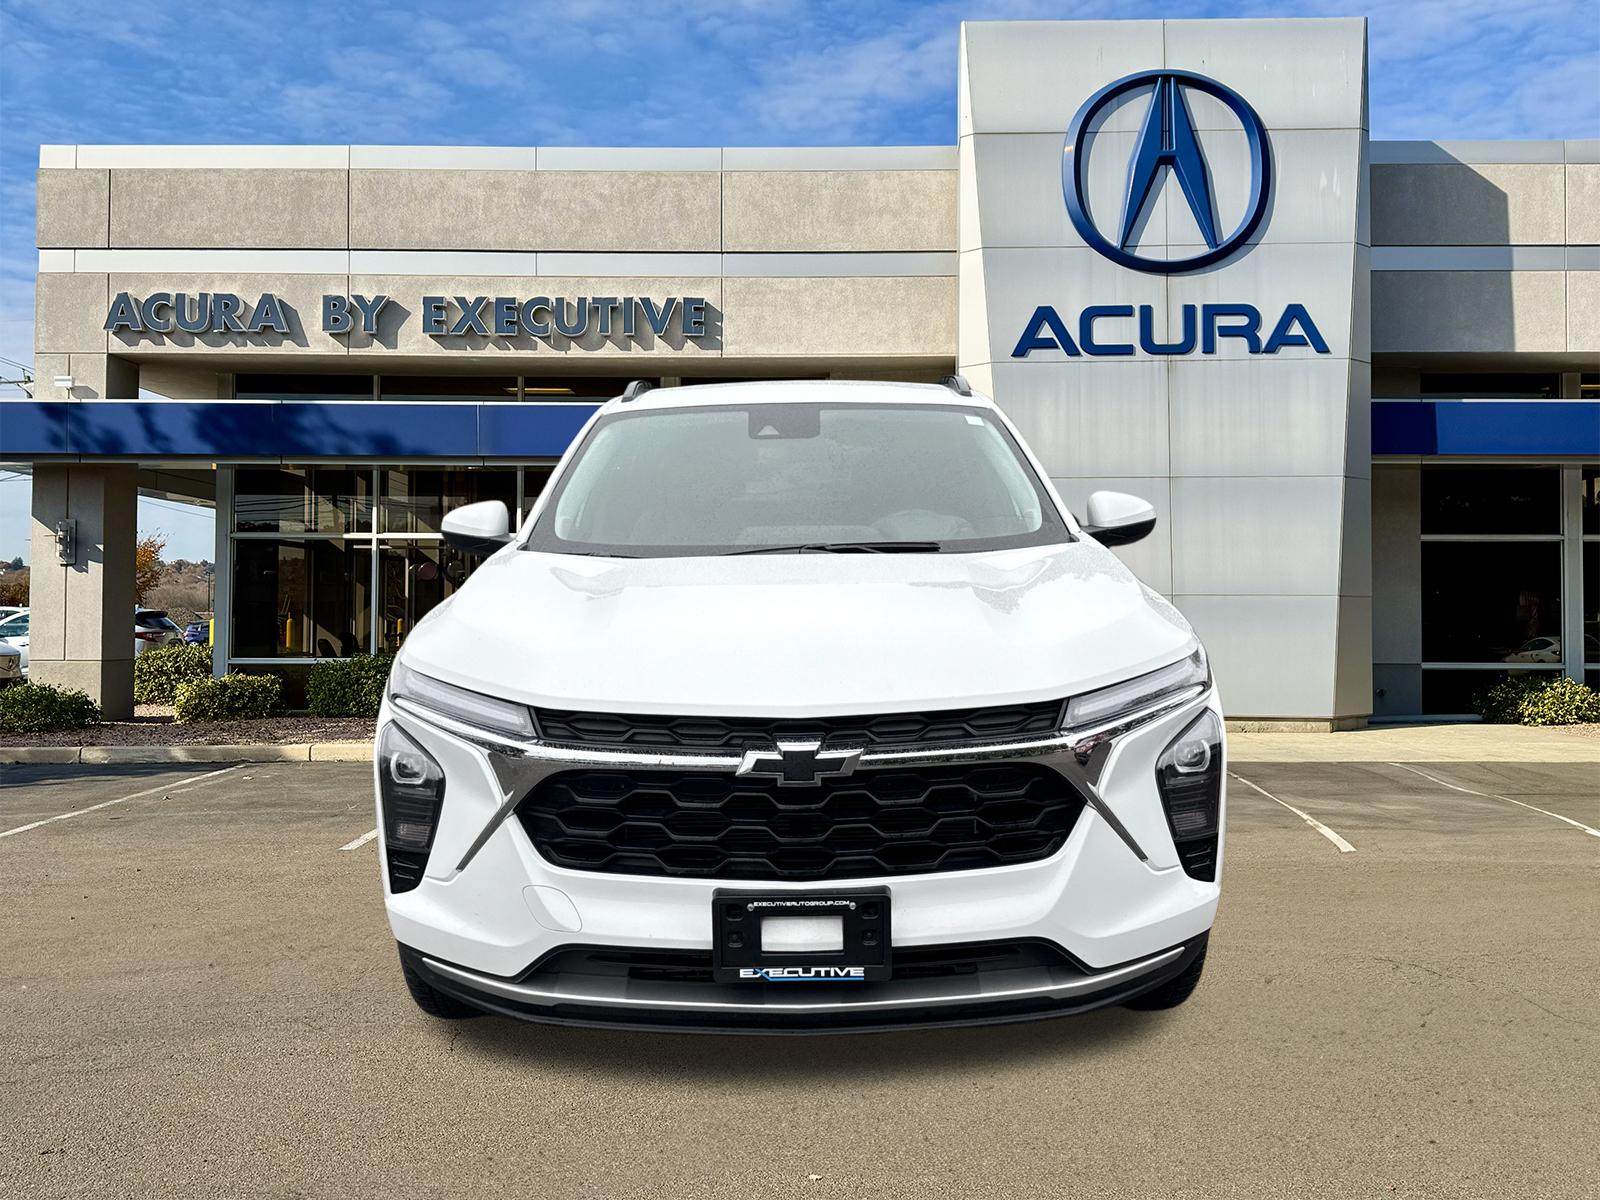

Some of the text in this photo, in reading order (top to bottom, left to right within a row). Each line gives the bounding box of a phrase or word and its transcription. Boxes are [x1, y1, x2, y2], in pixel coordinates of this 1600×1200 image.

[104, 291, 707, 338] ACURA BY EXECUTIVE
[1011, 303, 1332, 357] ACURA
[739, 967, 865, 980] EXECUTIVE
